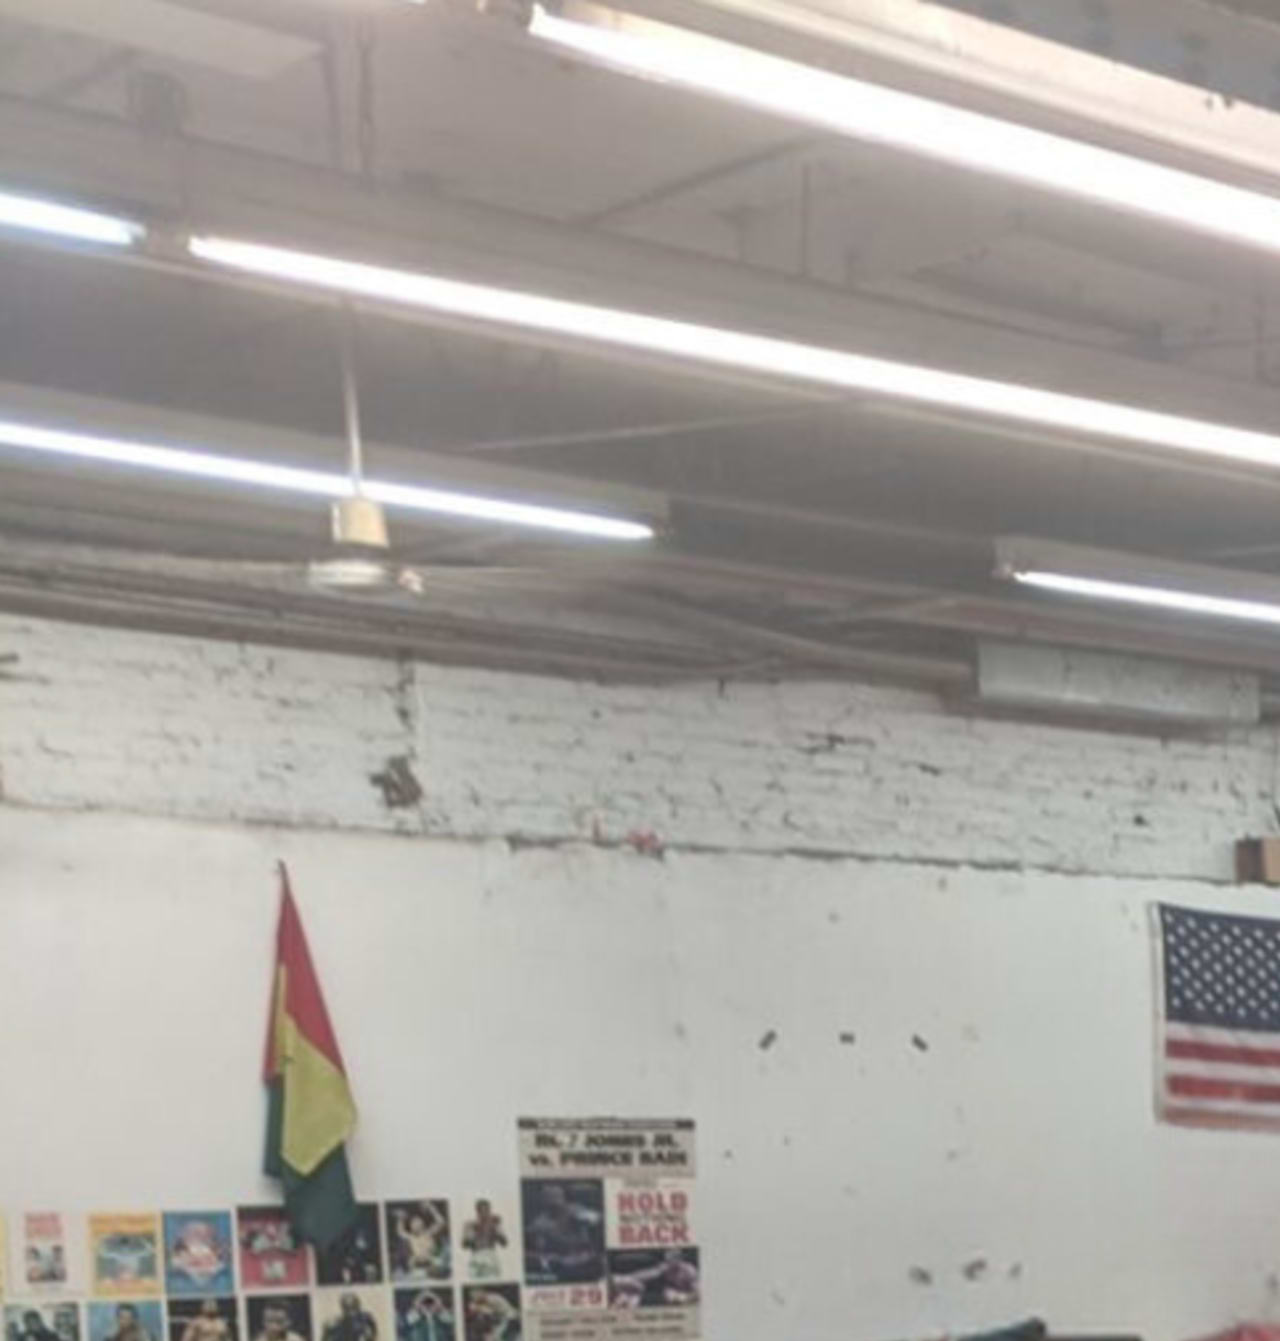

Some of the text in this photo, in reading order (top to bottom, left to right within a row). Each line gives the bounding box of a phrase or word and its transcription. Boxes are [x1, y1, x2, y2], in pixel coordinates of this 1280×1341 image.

[617, 1192, 688, 1212] HOLD
[619, 1226, 691, 1244] BACK
[570, 1287, 602, 1305] 29
